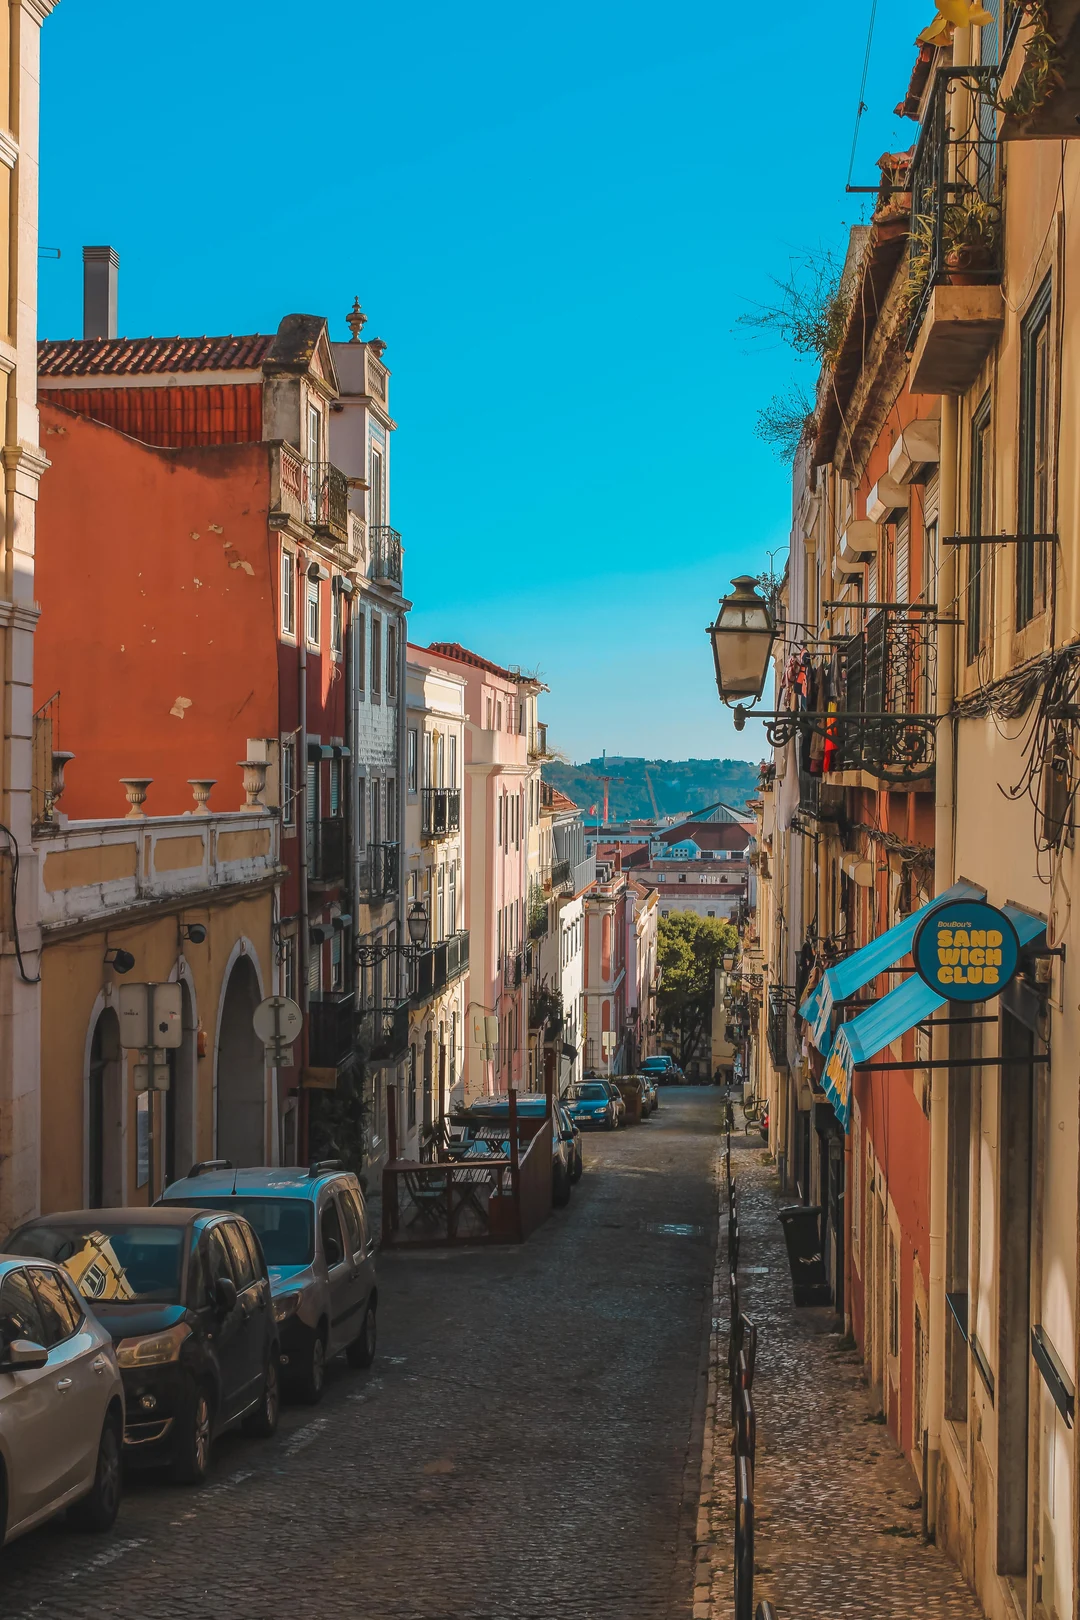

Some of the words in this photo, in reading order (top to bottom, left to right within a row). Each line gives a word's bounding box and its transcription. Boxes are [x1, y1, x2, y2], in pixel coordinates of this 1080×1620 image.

[937, 929, 1003, 947] SAND
[937, 948, 1002, 966] WICH
[937, 966, 1000, 984] CLUB
